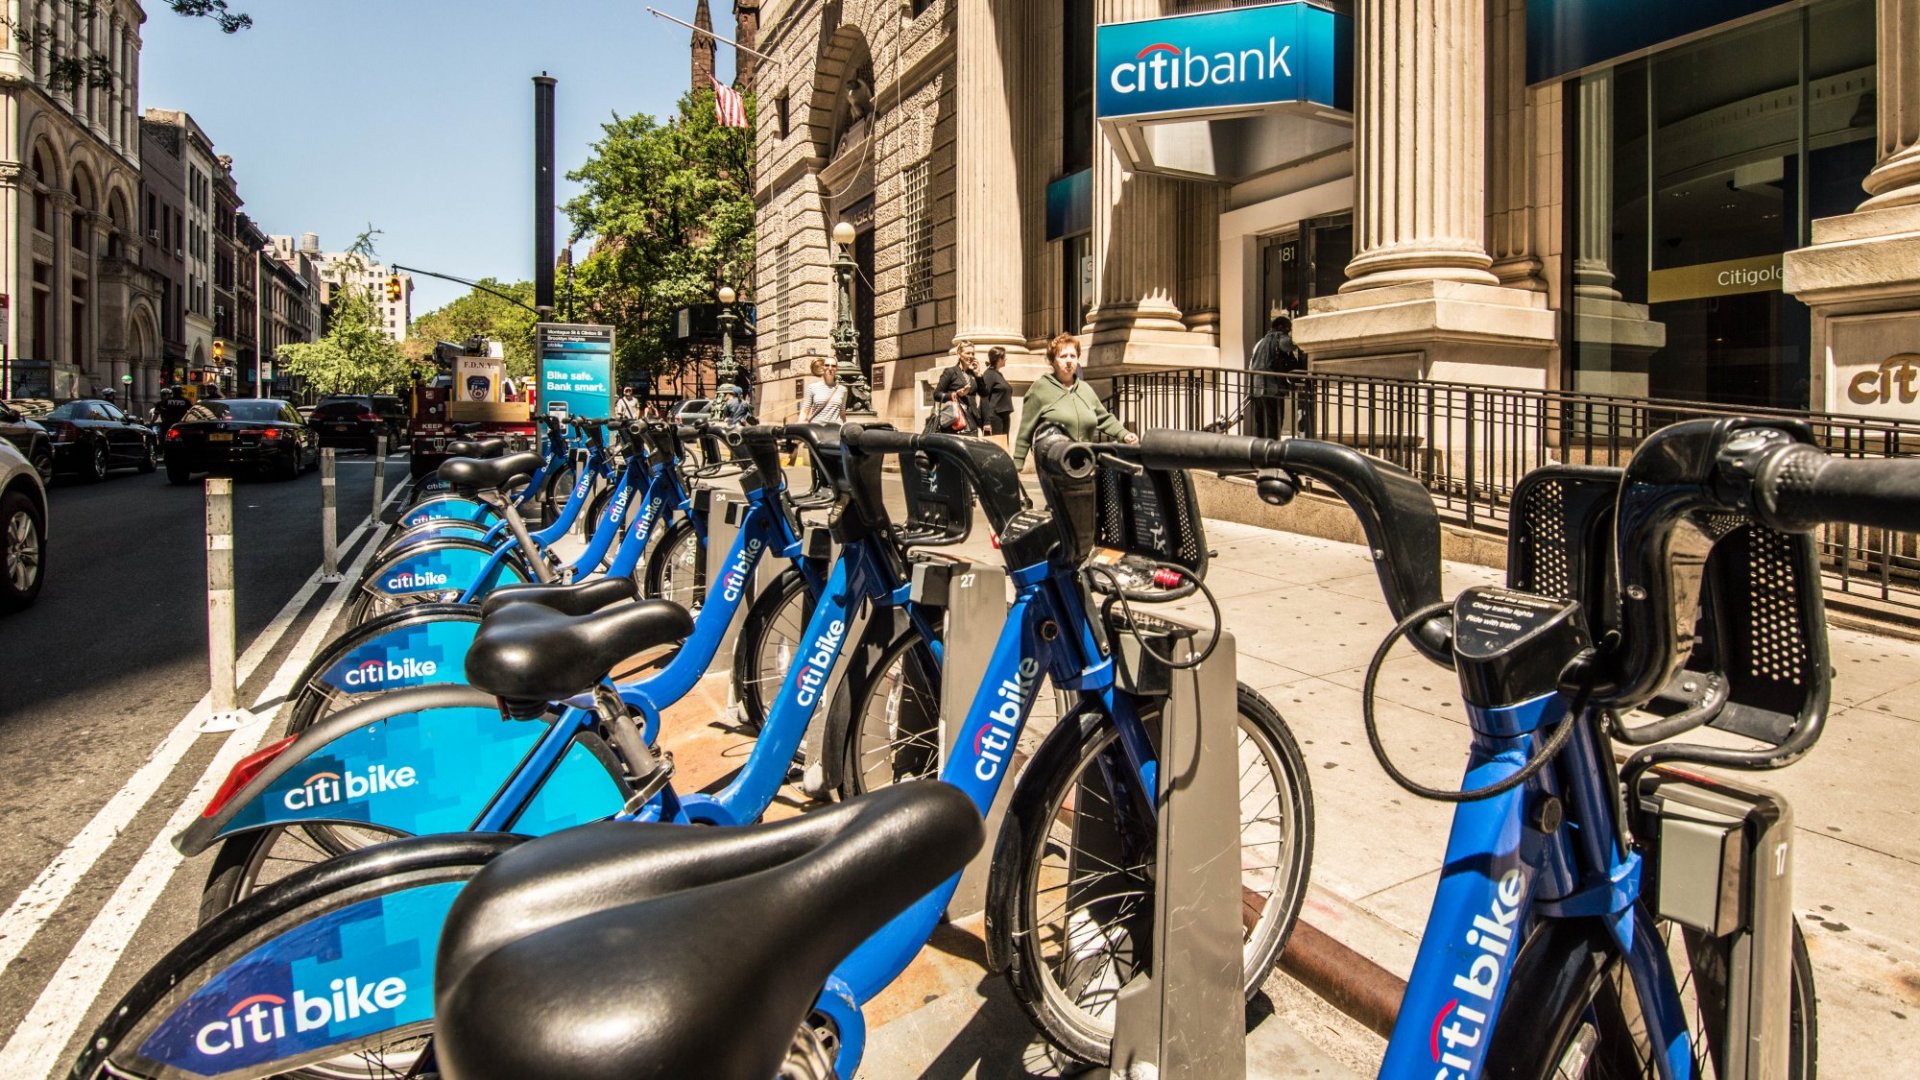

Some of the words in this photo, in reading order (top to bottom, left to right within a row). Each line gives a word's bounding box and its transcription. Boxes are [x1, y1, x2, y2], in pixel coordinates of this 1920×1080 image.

[1111, 36, 1292, 93] citibank
[1279, 246, 1295, 261] 181
[547, 370, 568, 380] Bike
[571, 371, 593, 381] safe.
[547, 381, 571, 391] Bank
[575, 382, 606, 392] smart.
[641, 497, 662, 522] bike
[715, 494, 727, 502] 24
[635, 519, 649, 540] citi
[733, 538, 761, 572] bike
[388, 573, 413, 589] citi
[415, 571, 447, 587] bike
[723, 571, 745, 602] citi
[961, 574, 976, 588] 27
[1465, 614, 1483, 623] Ride
[1483, 618, 1500, 627] with
[1499, 620, 1522, 631] traffic
[1472, 601, 1492, 611] Obey
[1491, 605, 1514, 614] traffic
[1513, 608, 1535, 618] lights
[808, 619, 845, 670] bike
[345, 659, 384, 686] citi
[387, 658, 437, 680] bike
[797, 665, 824, 707] citi
[989, 657, 1039, 728] bike
[974, 722, 1012, 781] citi
[284, 771, 341, 810] citi
[345, 764, 417, 799] bike
[1775, 842, 1788, 876] 17
[1453, 868, 1526, 1000] bike
[196, 994, 286, 1055] citi
[292, 976, 407, 1033] bike
